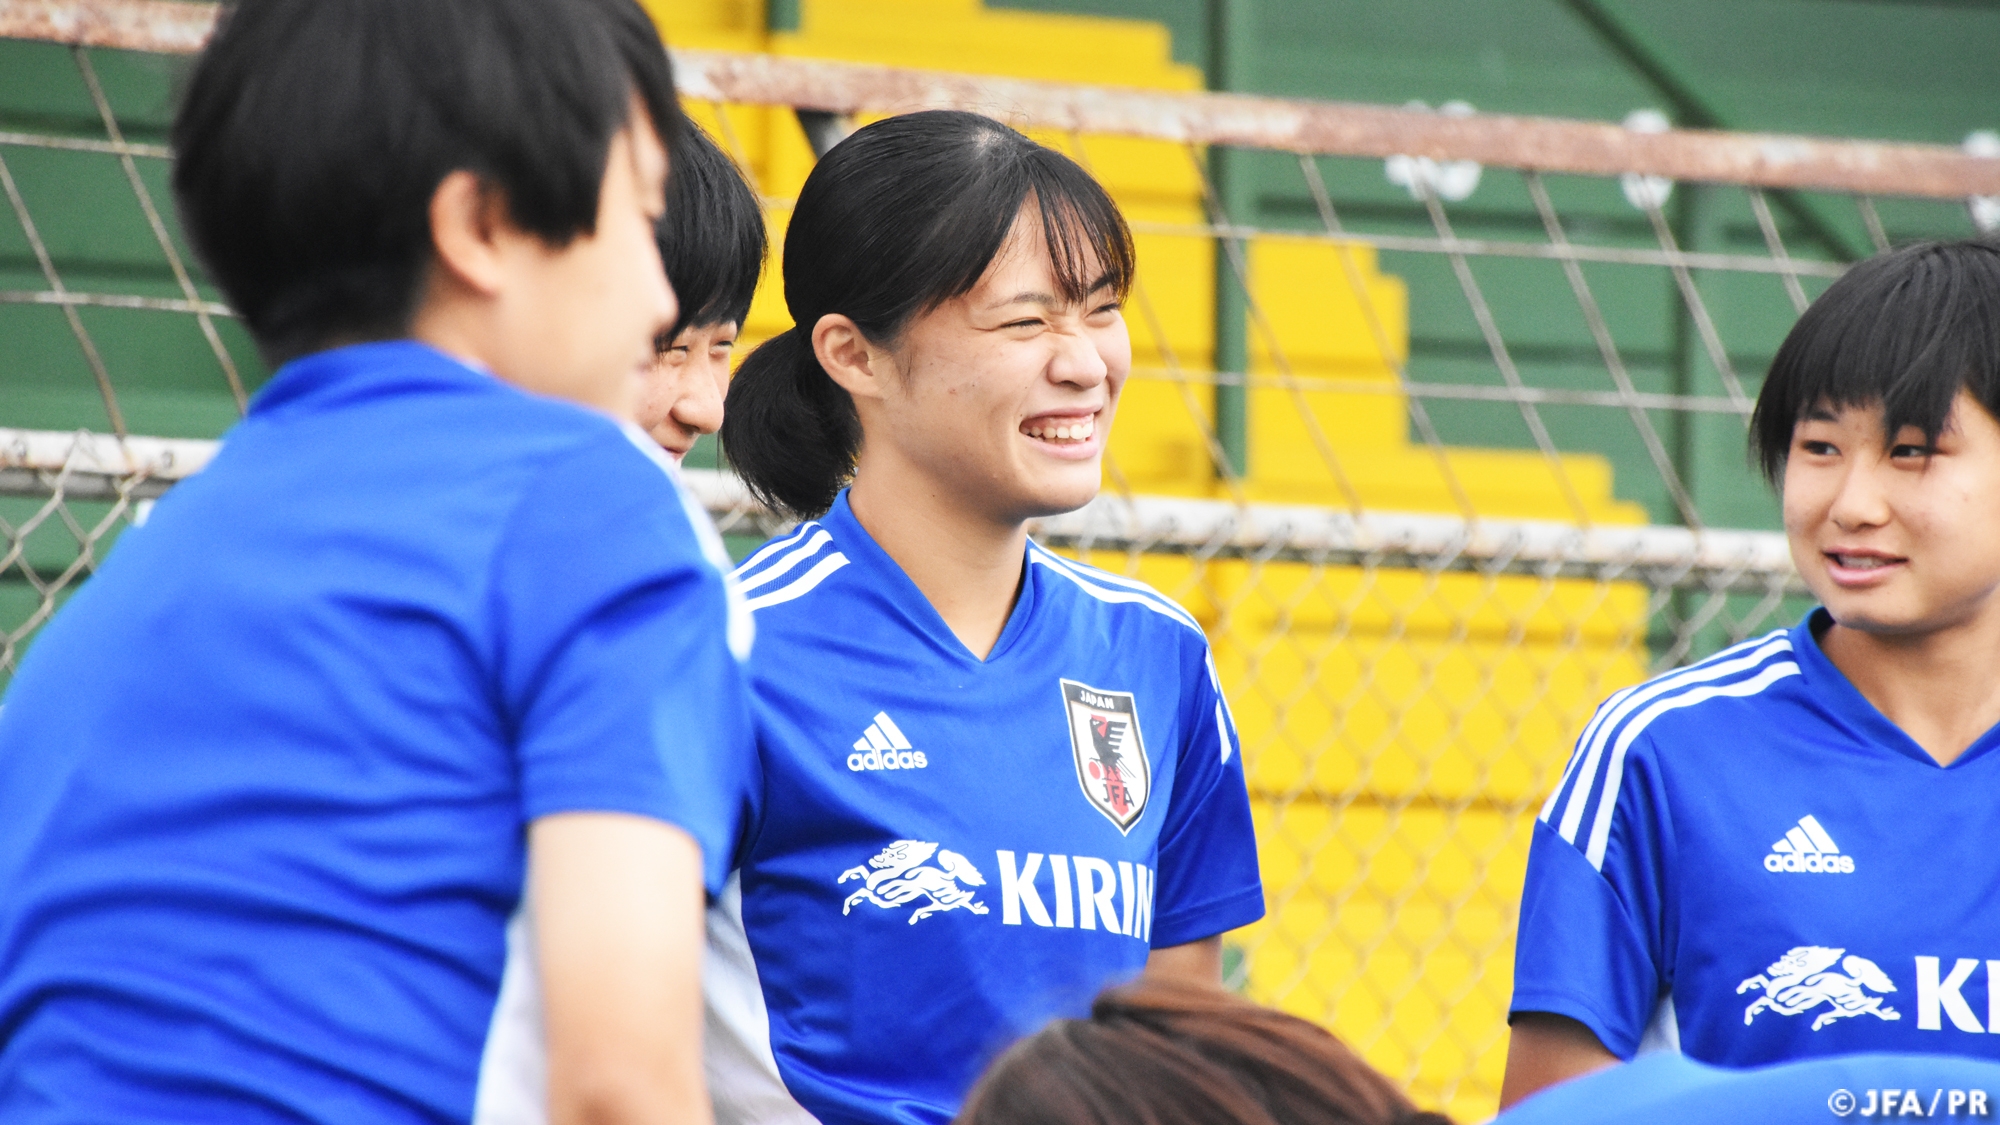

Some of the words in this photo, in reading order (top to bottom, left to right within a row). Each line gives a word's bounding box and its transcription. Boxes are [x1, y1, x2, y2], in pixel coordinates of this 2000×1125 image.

[1080, 691, 1115, 710] JAPAN
[847, 747, 928, 771] adidas
[1103, 784, 1135, 808] JFA
[1763, 853, 1855, 873] adidas
[996, 850, 1154, 943] KIRIN
